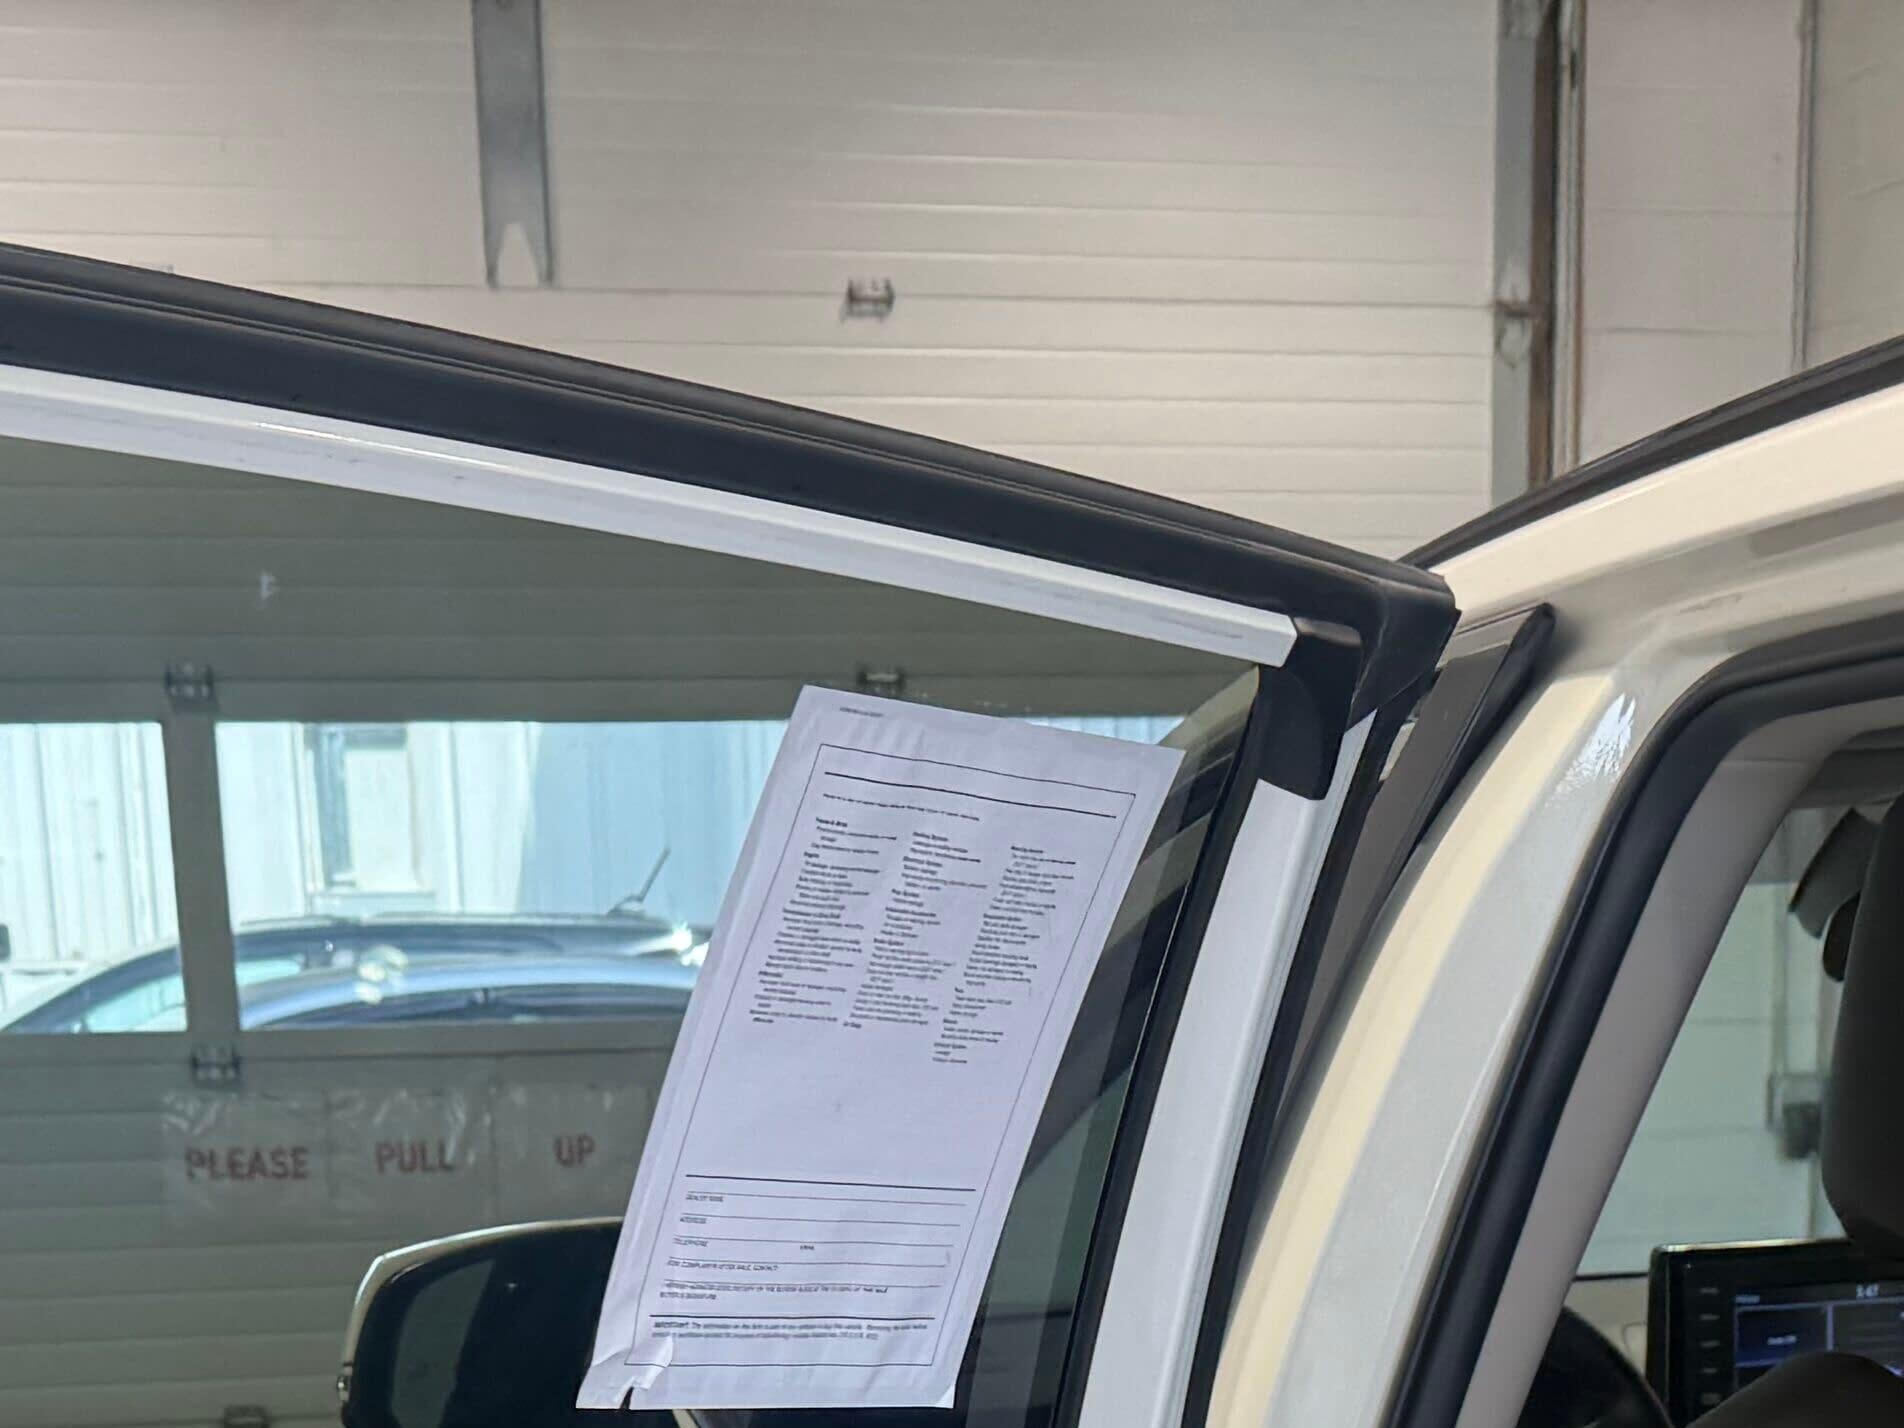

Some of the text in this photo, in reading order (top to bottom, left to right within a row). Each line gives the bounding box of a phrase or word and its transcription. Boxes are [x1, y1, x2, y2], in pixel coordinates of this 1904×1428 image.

[184, 1133, 596, 1181] PLEASE PULL UP
